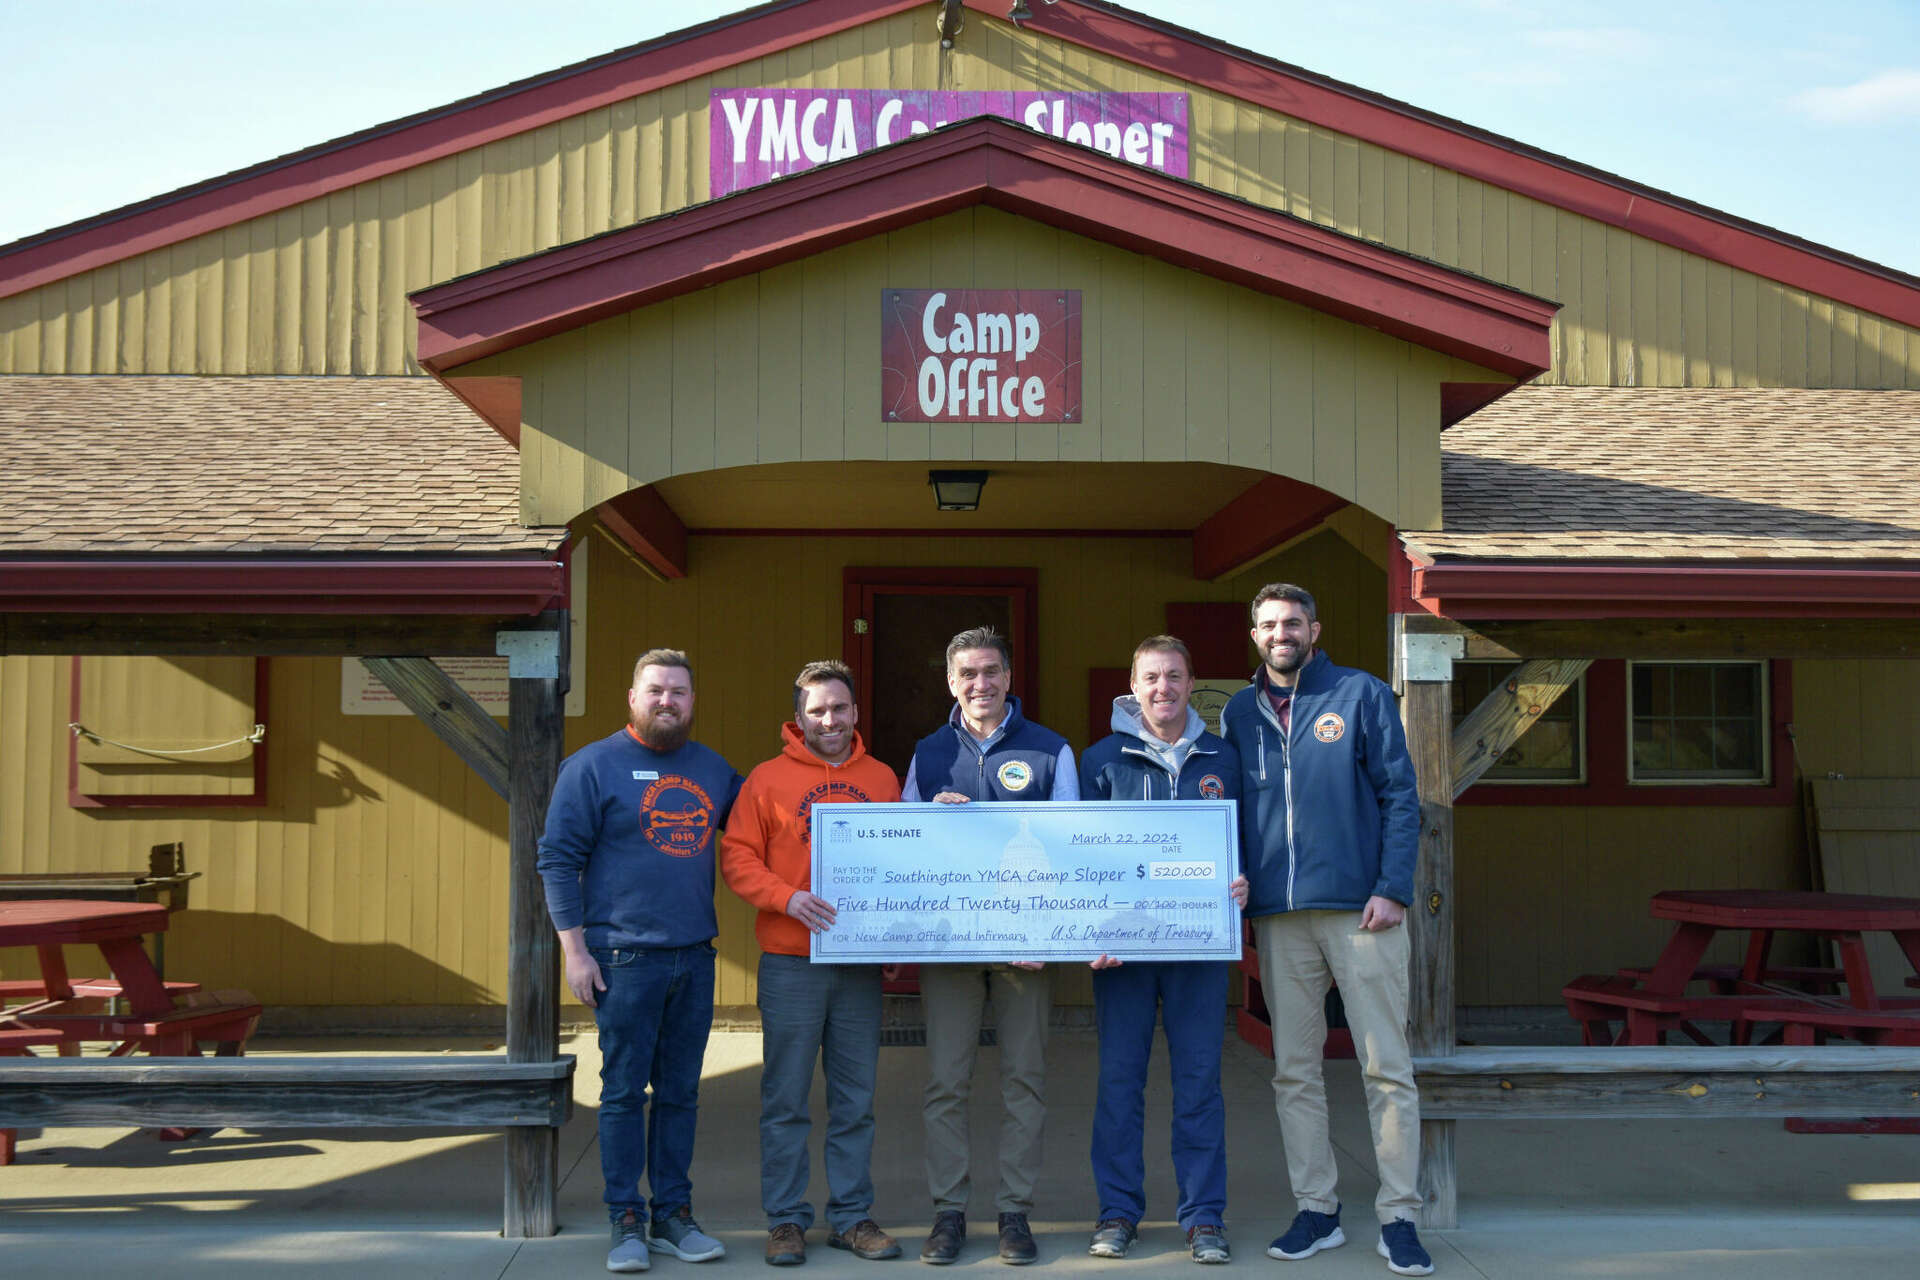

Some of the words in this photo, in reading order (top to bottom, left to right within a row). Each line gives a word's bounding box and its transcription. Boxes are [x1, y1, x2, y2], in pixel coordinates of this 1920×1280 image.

[720, 98, 859, 163] YMCA
[922, 292, 1040, 362] Camp
[918, 356, 1045, 417] Office
[797, 791, 816, 817] YMCA
[857, 829, 879, 838] U.S.
[881, 829, 921, 838] SENATE
[1072, 833, 1111, 844] March
[1116, 834, 1138, 844] 22,
[1143, 833, 1179, 843] 2024
[833, 866, 848, 874] PAY
[849, 866, 861, 874] TO
[863, 866, 877, 874] THE
[883, 870, 971, 886] Southington
[977, 869, 1022, 882] YMCA
[1027, 868, 1069, 885] Camp
[1074, 866, 1126, 886] Sloper
[1136, 864, 1145, 879] $
[1154, 866, 1212, 878] 520,000
[833, 876, 861, 884] ORDER
[863, 876, 874, 884] OF
[835, 896, 868, 911] Five
[876, 896, 950, 911] Hundred
[957, 897, 1021, 914] Twenty
[1028, 894, 1108, 910] Thousand
[833, 934, 849, 943] FOR
[855, 932, 878, 942] New
[882, 931, 913, 944] Camp
[917, 931, 950, 942] Office
[951, 931, 971, 942] and
[1051, 925, 1076, 940] U.S.
[1083, 925, 1144, 943] Department
[1147, 924, 1160, 943] of
[1165, 924, 1213, 943] Treasury
